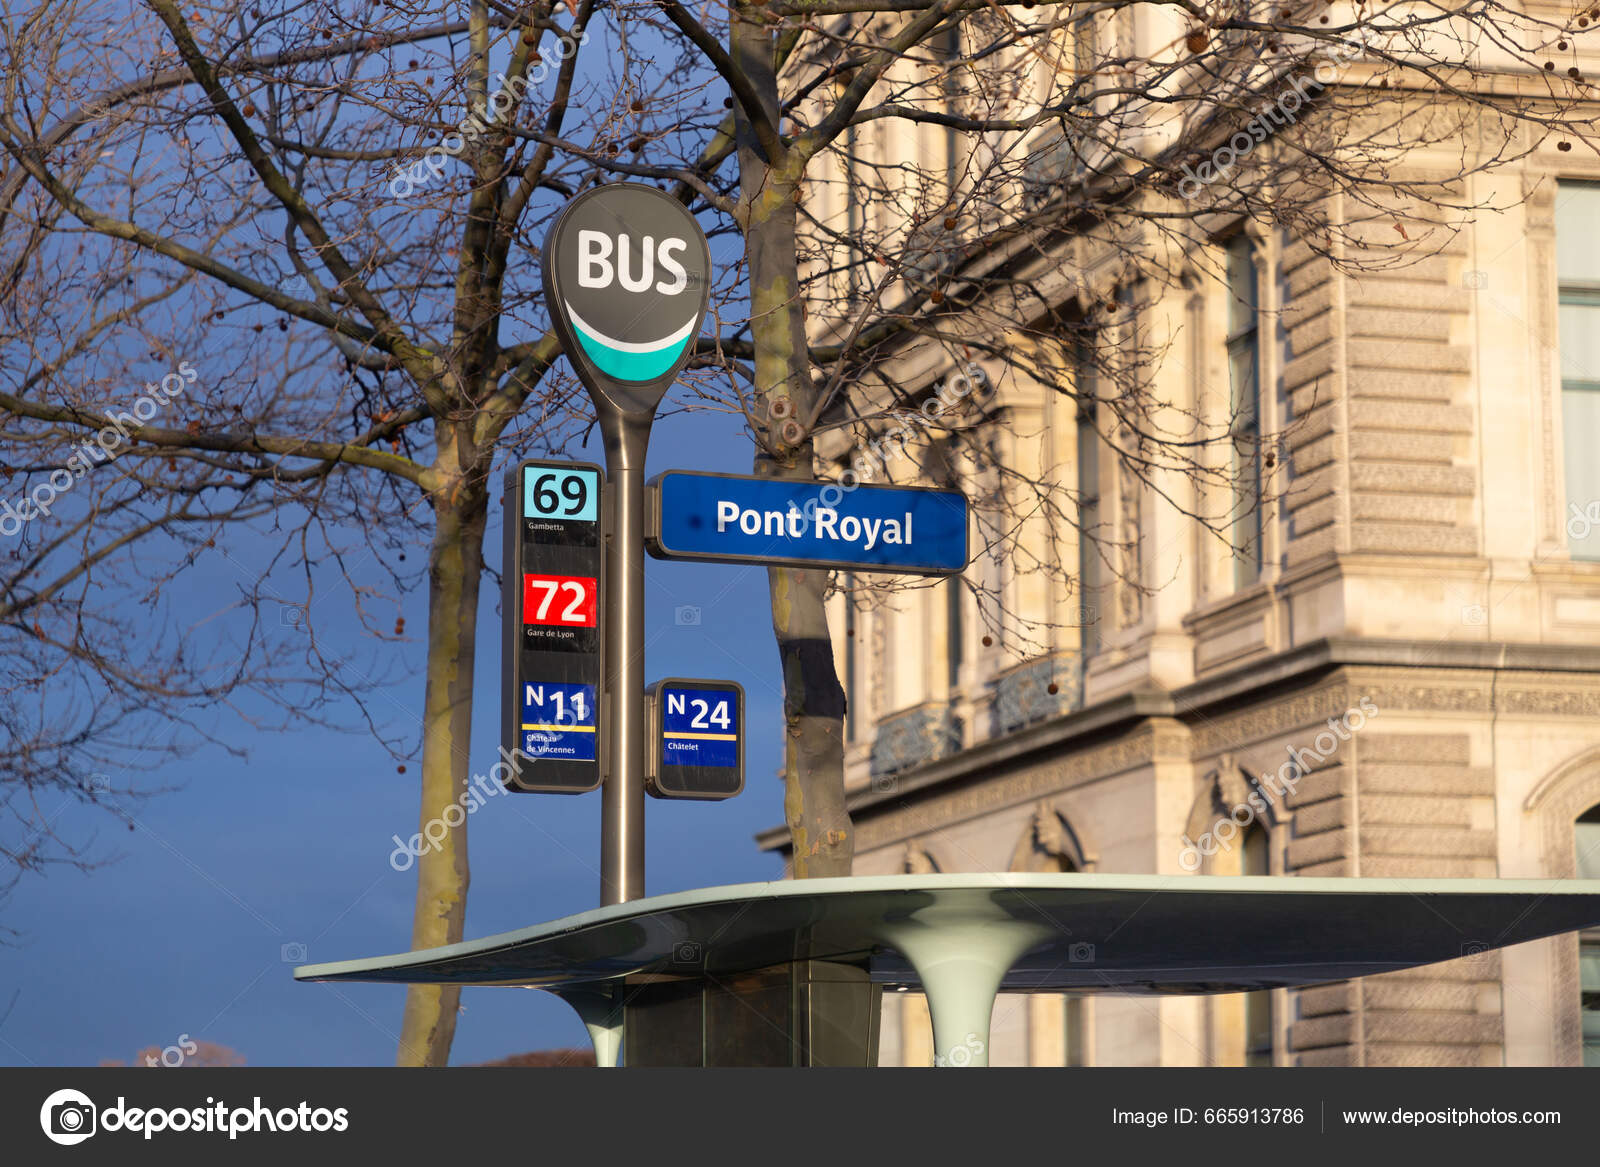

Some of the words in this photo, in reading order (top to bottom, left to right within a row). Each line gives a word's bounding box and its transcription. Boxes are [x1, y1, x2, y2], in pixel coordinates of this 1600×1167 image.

[578, 229, 687, 296] BUS
[533, 474, 587, 516] 69
[528, 522, 564, 531] Gambetta
[717, 501, 803, 538] Pont
[815, 507, 912, 550] Royal
[532, 580, 586, 622] 72
[527, 628, 545, 637] Gare
[546, 629, 555, 637] de
[557, 630, 575, 639] Lyon
[526, 744, 537, 753] de
[538, 745, 576, 754] Vincennes
[668, 741, 699, 751] Châtelet
